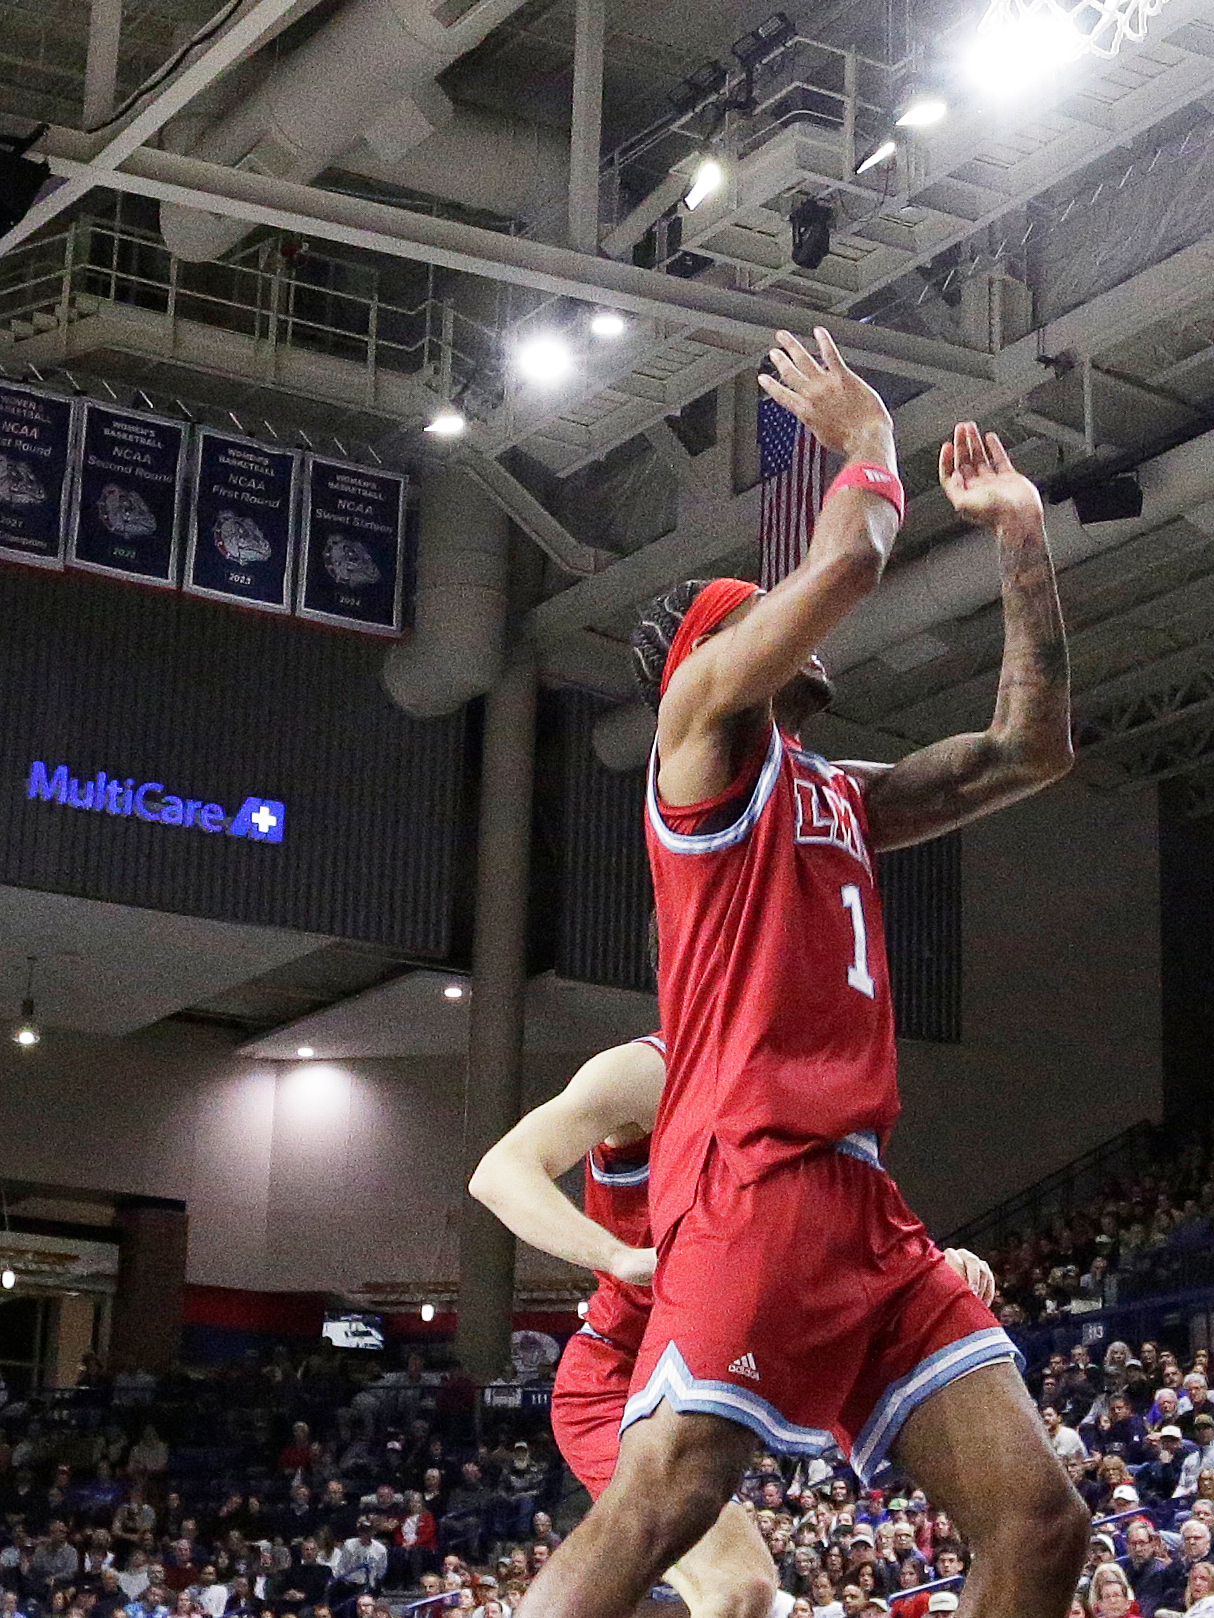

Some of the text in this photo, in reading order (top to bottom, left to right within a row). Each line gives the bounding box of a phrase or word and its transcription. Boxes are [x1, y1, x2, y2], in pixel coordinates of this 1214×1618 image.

[2, 421, 39, 440] NCAA
[87, 454, 133, 474] Second
[112, 446, 152, 464] NCAA
[228, 473, 265, 491] NCAA
[212, 484, 281, 509] First Round
[337, 499, 373, 516] NCAA
[27, 760, 226, 833] MultiCare
[841, 884, 875, 999] 1
